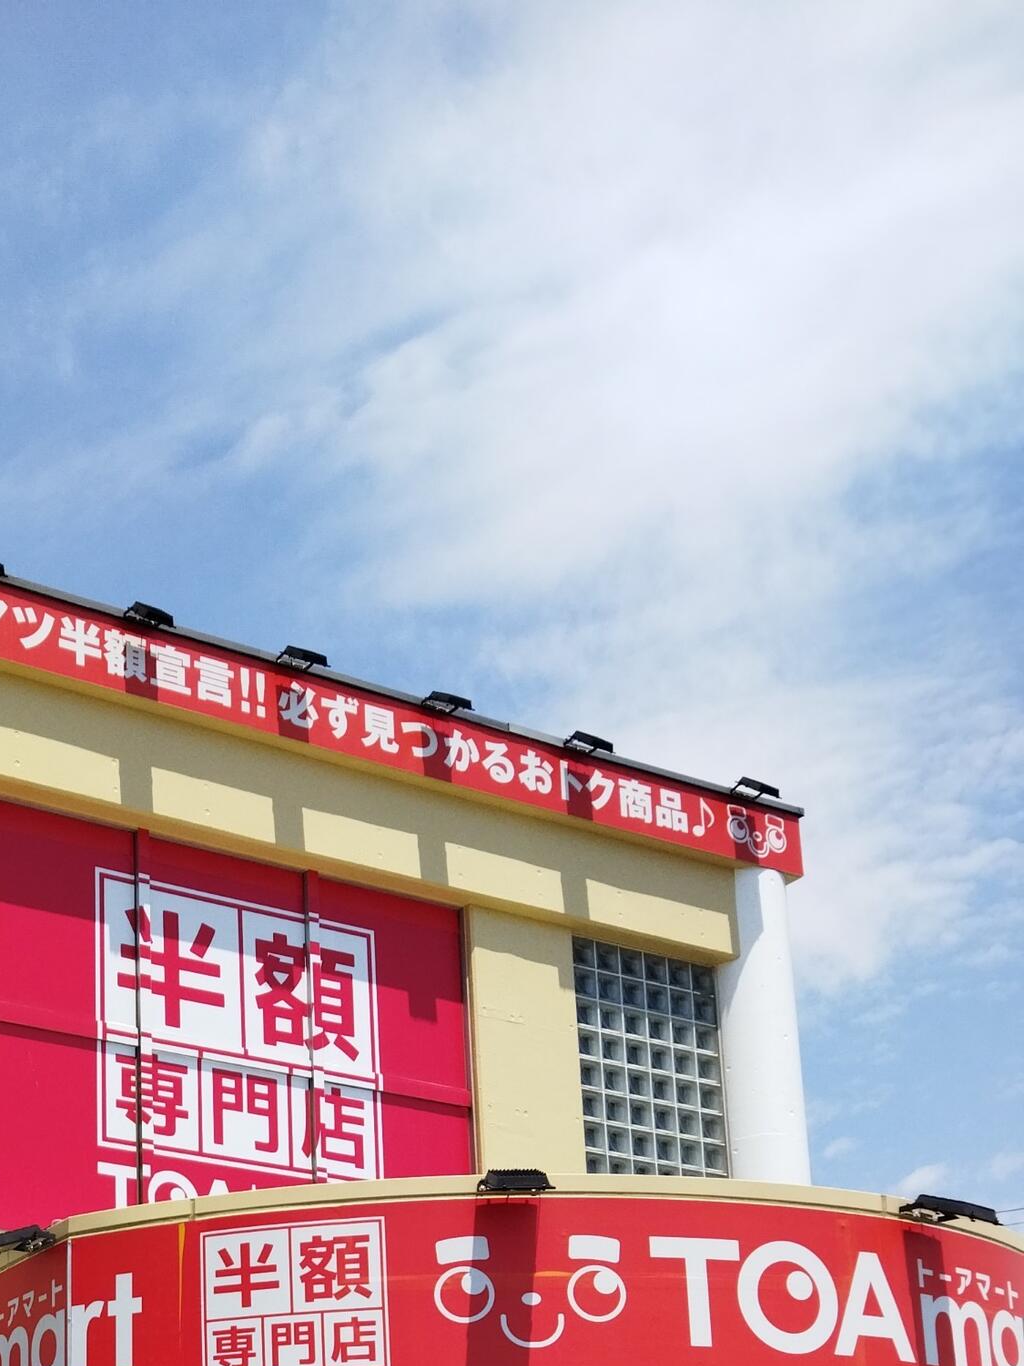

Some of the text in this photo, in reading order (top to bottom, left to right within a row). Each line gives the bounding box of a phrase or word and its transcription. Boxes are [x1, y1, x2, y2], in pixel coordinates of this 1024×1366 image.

[116, 905, 359, 1061] 半額
[115, 1053, 365, 1170] 専門店
[212, 1234, 374, 1309] 半額
[917, 1258, 1019, 1310] トーアマート
